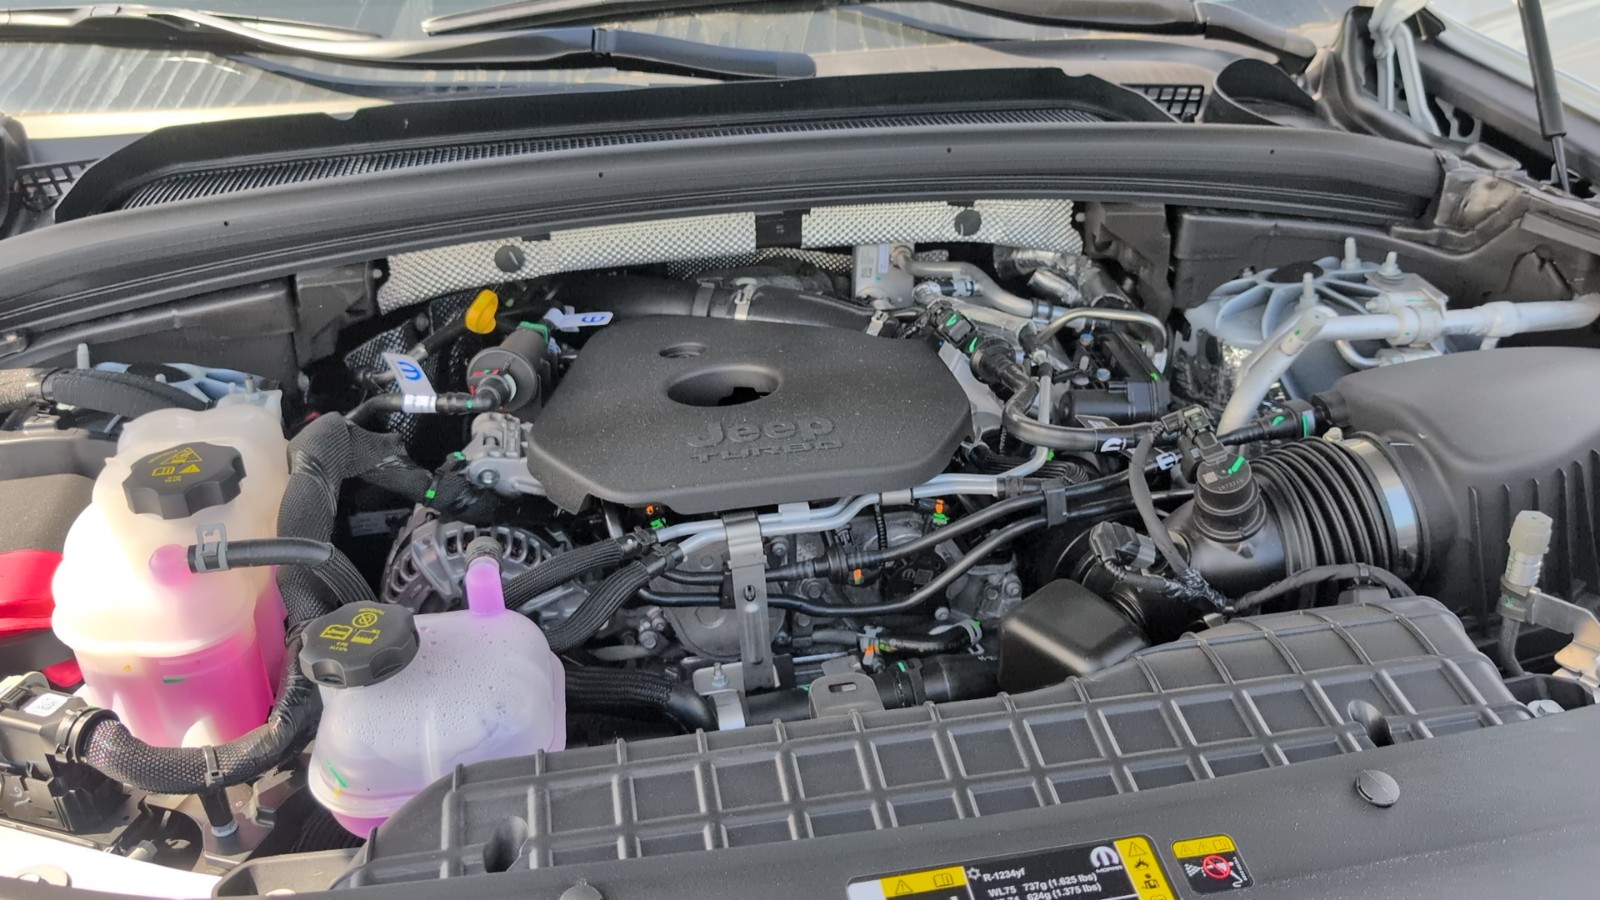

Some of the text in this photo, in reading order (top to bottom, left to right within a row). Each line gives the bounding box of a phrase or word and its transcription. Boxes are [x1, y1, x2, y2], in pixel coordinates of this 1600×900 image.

[687, 417, 836, 448] Jeep
[690, 440, 844, 463] TURBO
[982, 867, 1025, 882] R-1234yf
[988, 873, 1098, 898] WL75 737g (1.625 lbs)
[1027, 883, 1102, 900] 624g (1.375 lbs)
